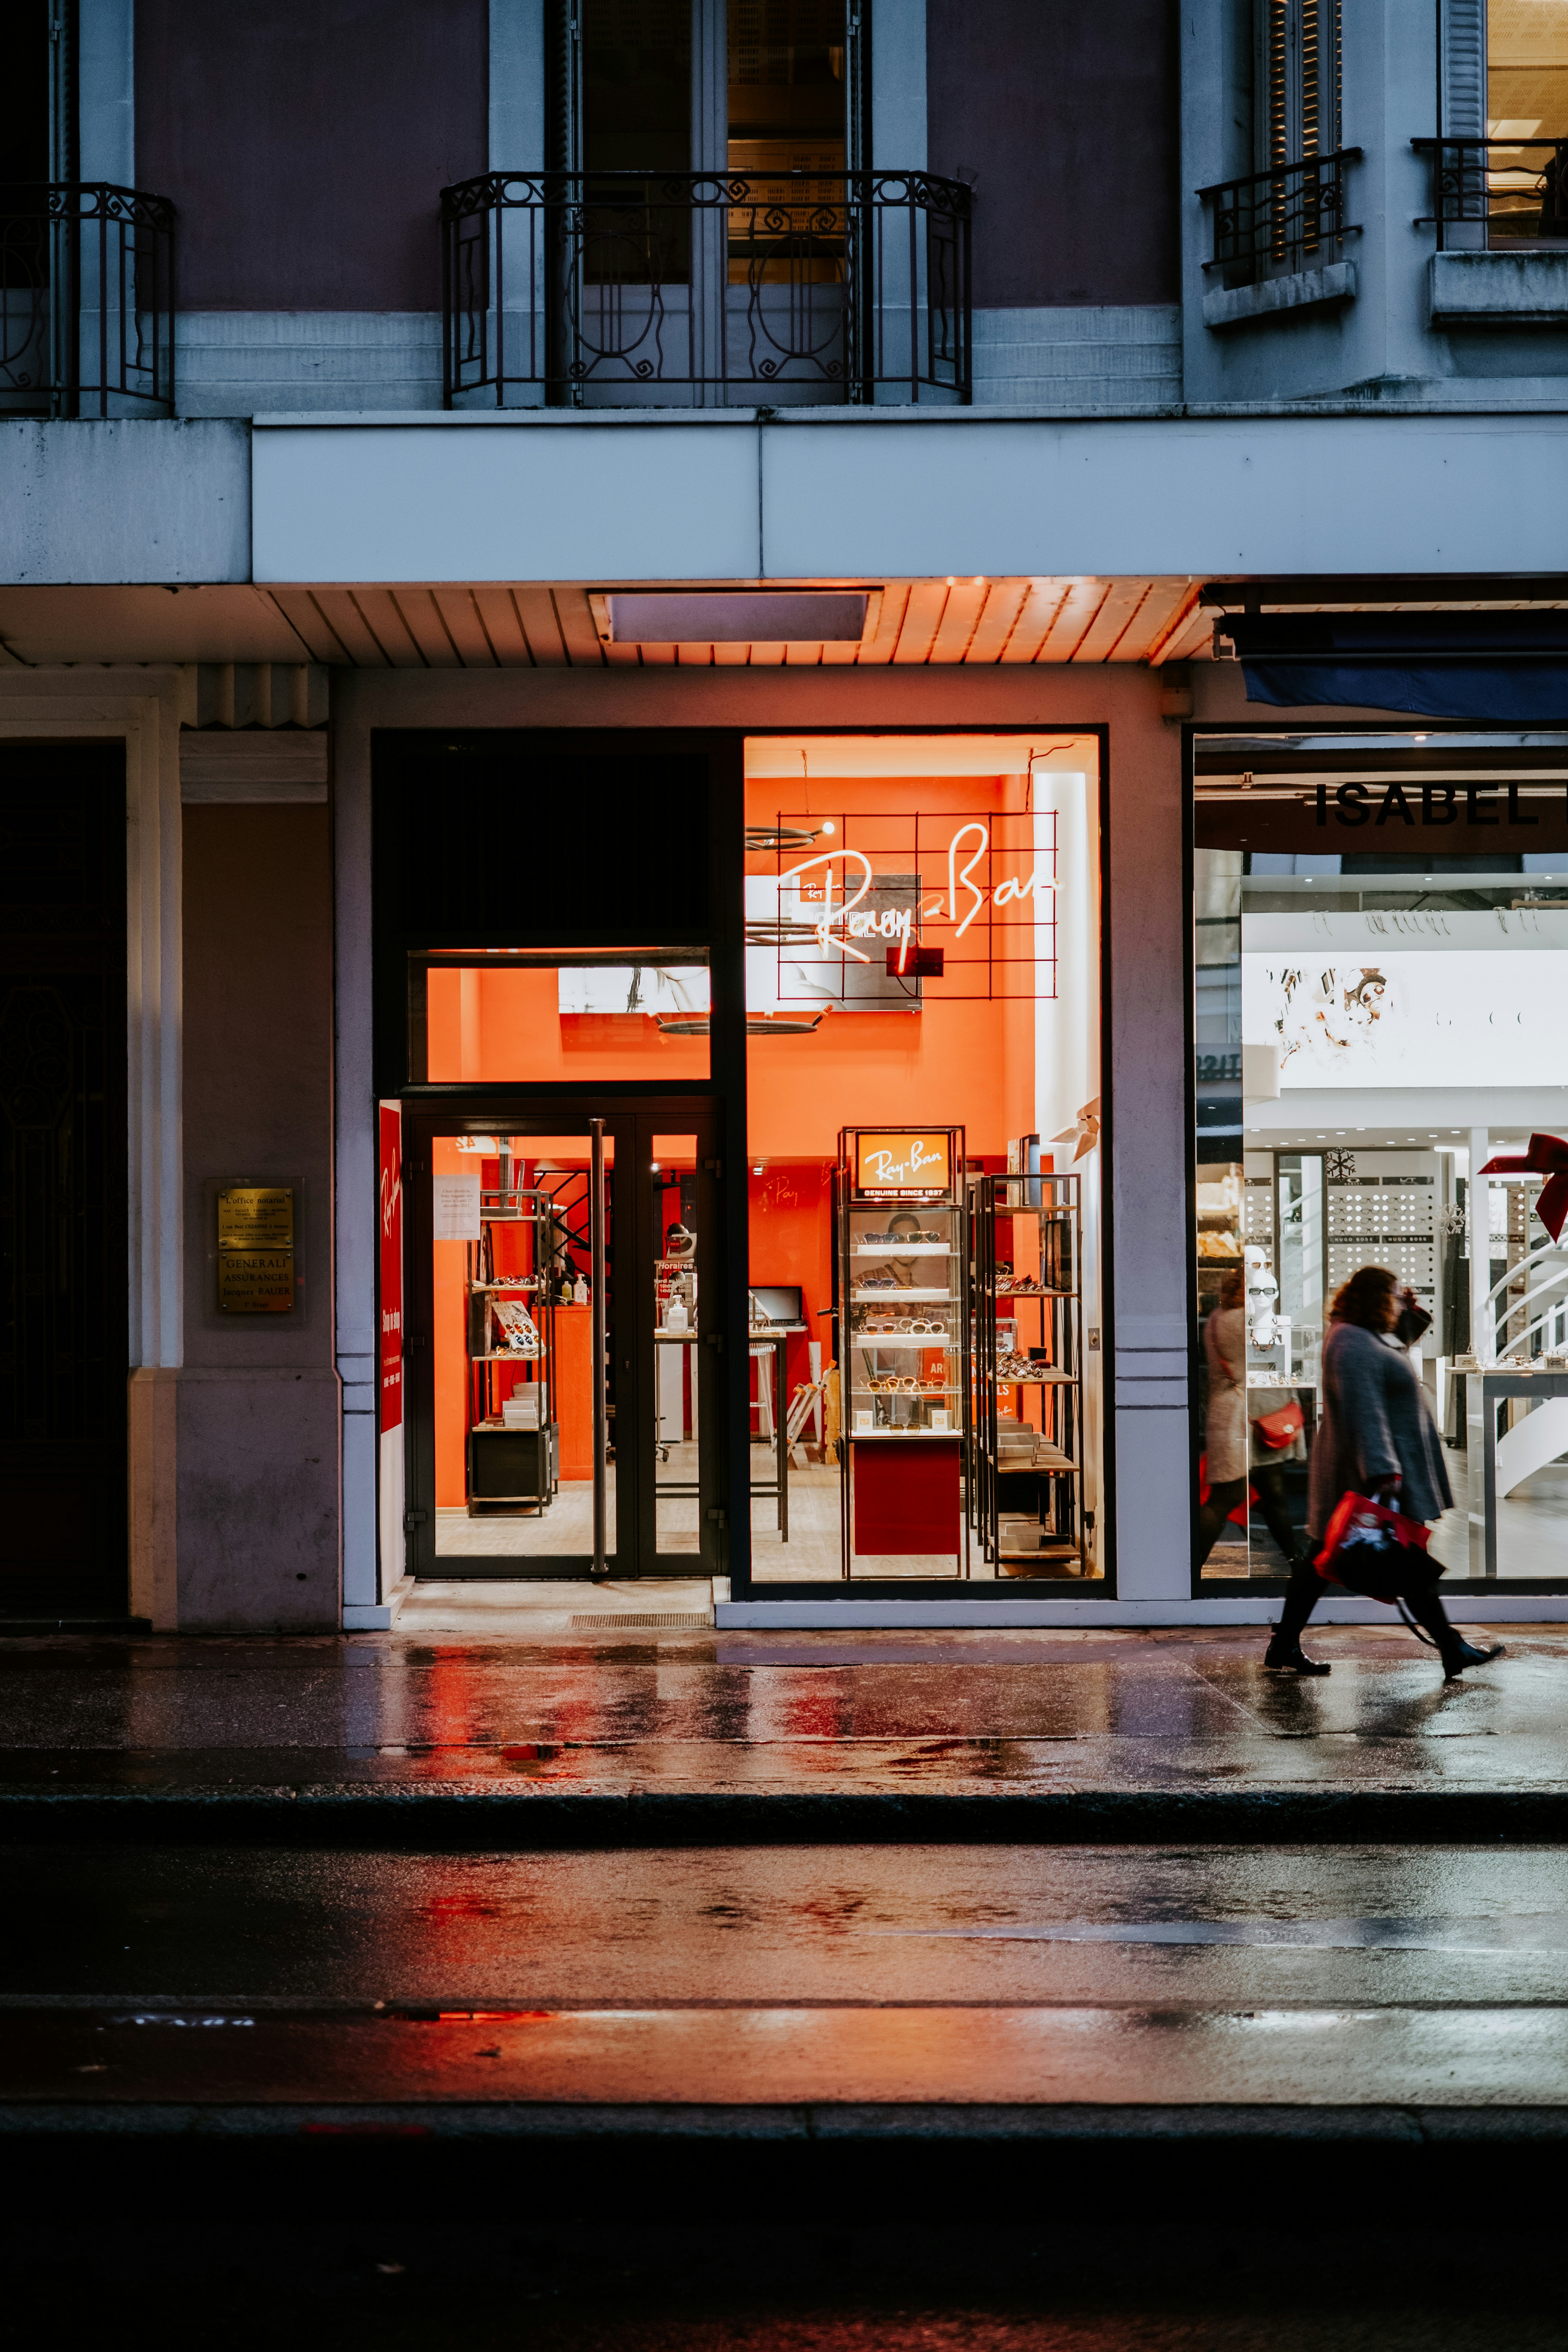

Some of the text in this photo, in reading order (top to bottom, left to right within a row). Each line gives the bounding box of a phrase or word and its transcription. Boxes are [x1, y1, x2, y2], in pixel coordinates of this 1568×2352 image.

[1316, 782, 1539, 826] ISABEL
[778, 823, 1065, 974] Ray-Ban
[865, 1140, 943, 1182] Ray-Ban
[226, 1259, 286, 1268] GENERALI
[224, 1273, 289, 1282] ASSURANCES
[223, 1287, 291, 1297] Jacques BAUER
